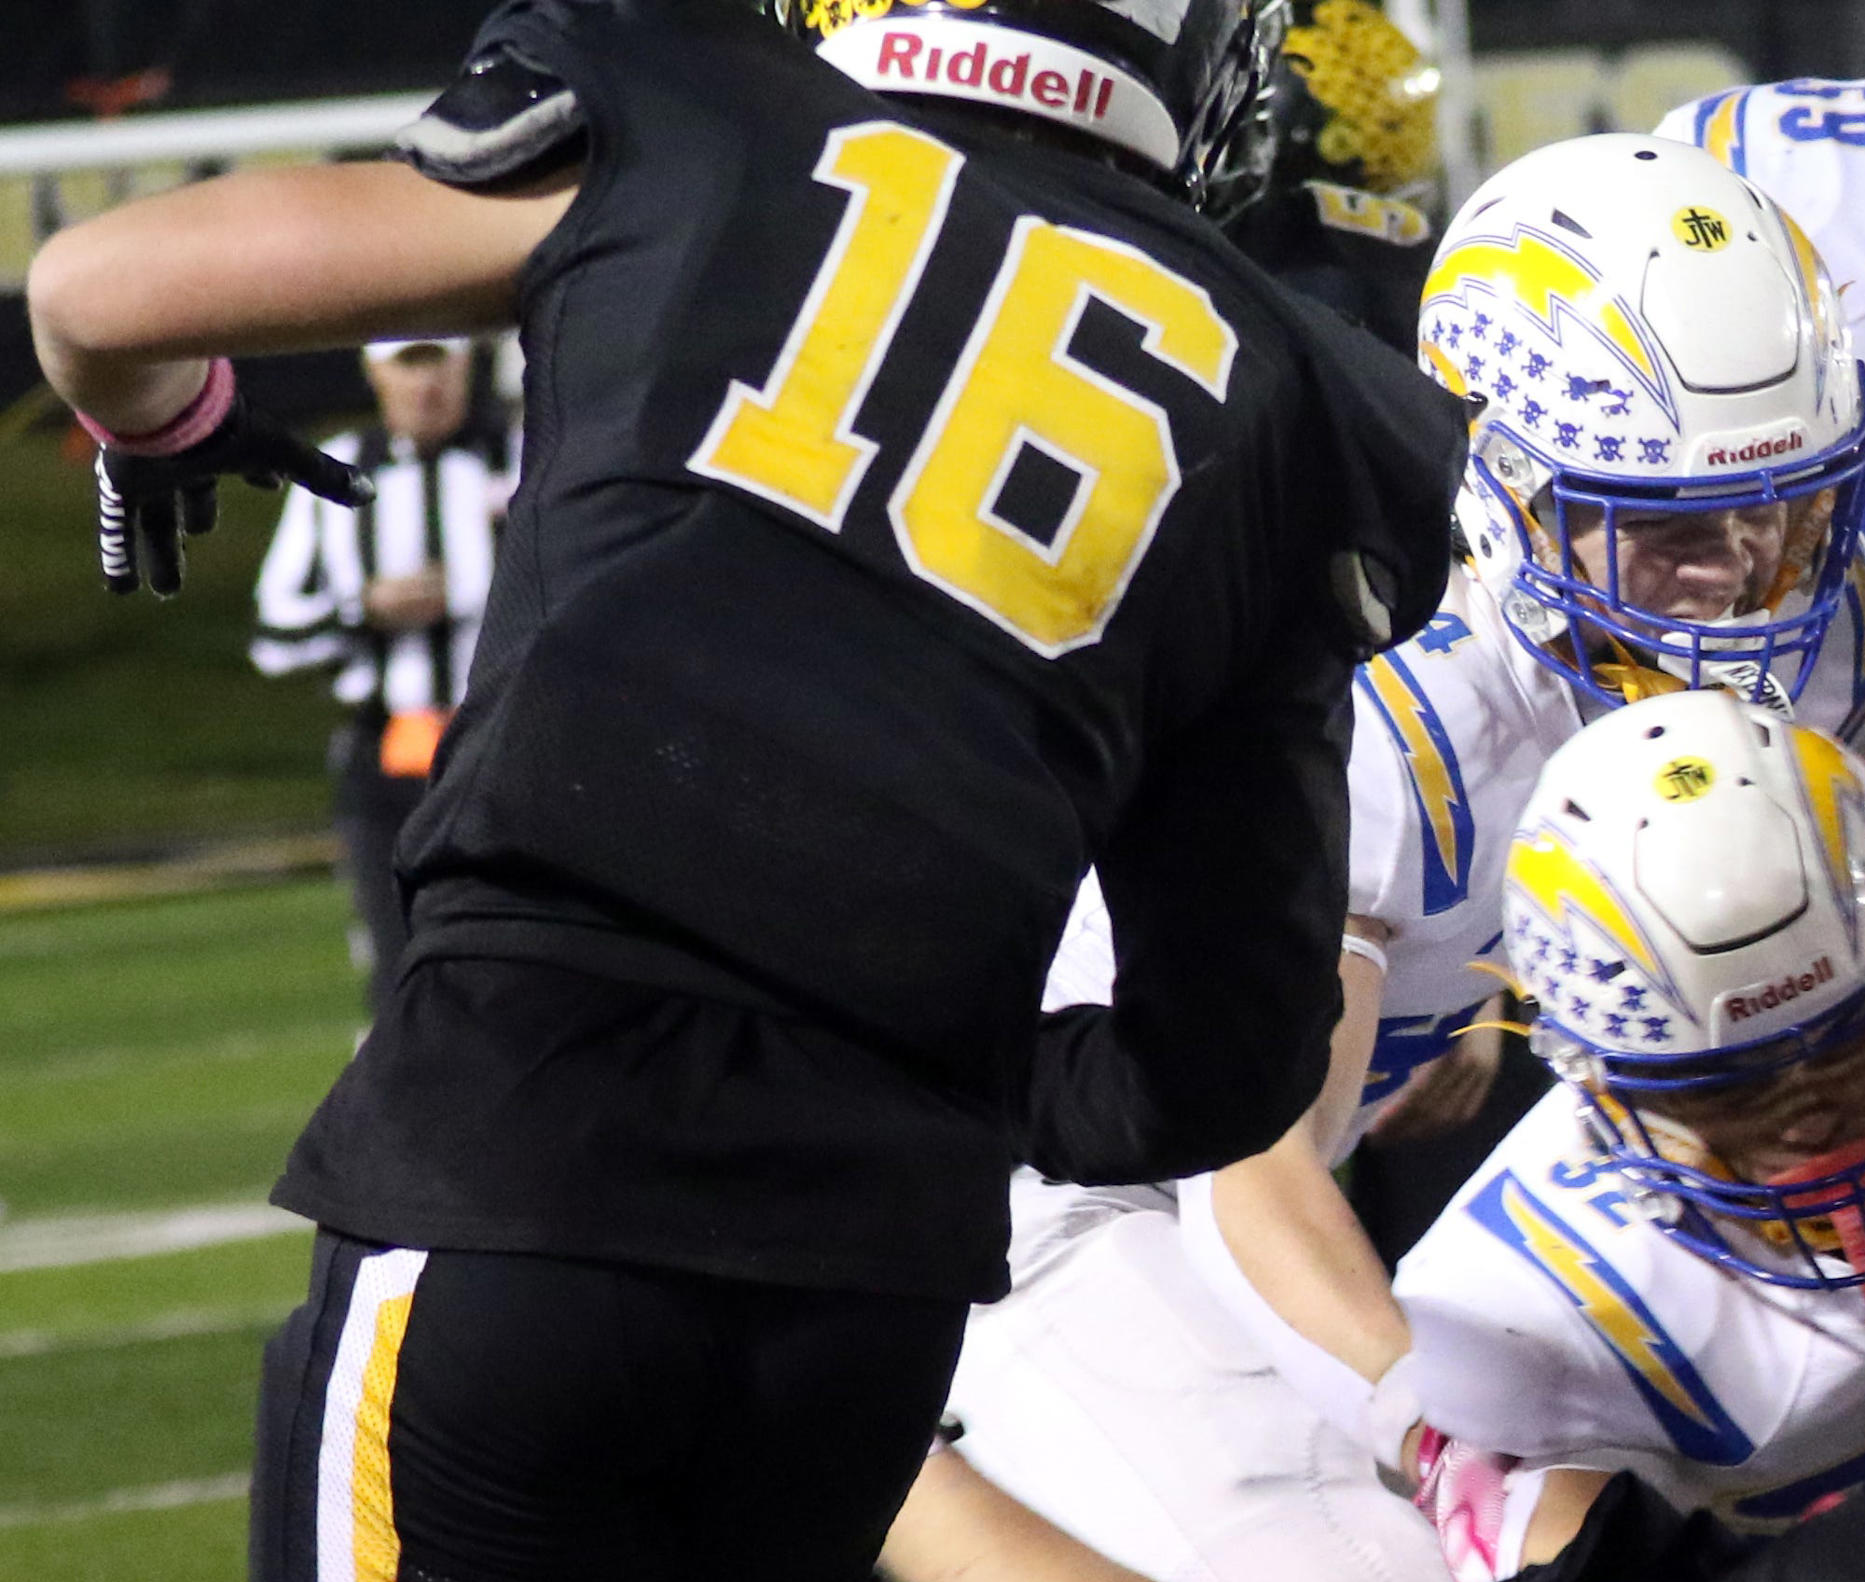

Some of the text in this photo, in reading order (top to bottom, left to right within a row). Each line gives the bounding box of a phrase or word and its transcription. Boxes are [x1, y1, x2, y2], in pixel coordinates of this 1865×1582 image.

[876, 30, 1114, 122] Riddell
[686, 120, 1239, 660] 16
[1707, 430, 1803, 466] Riddell
[1725, 956, 1834, 1022] Riddell
